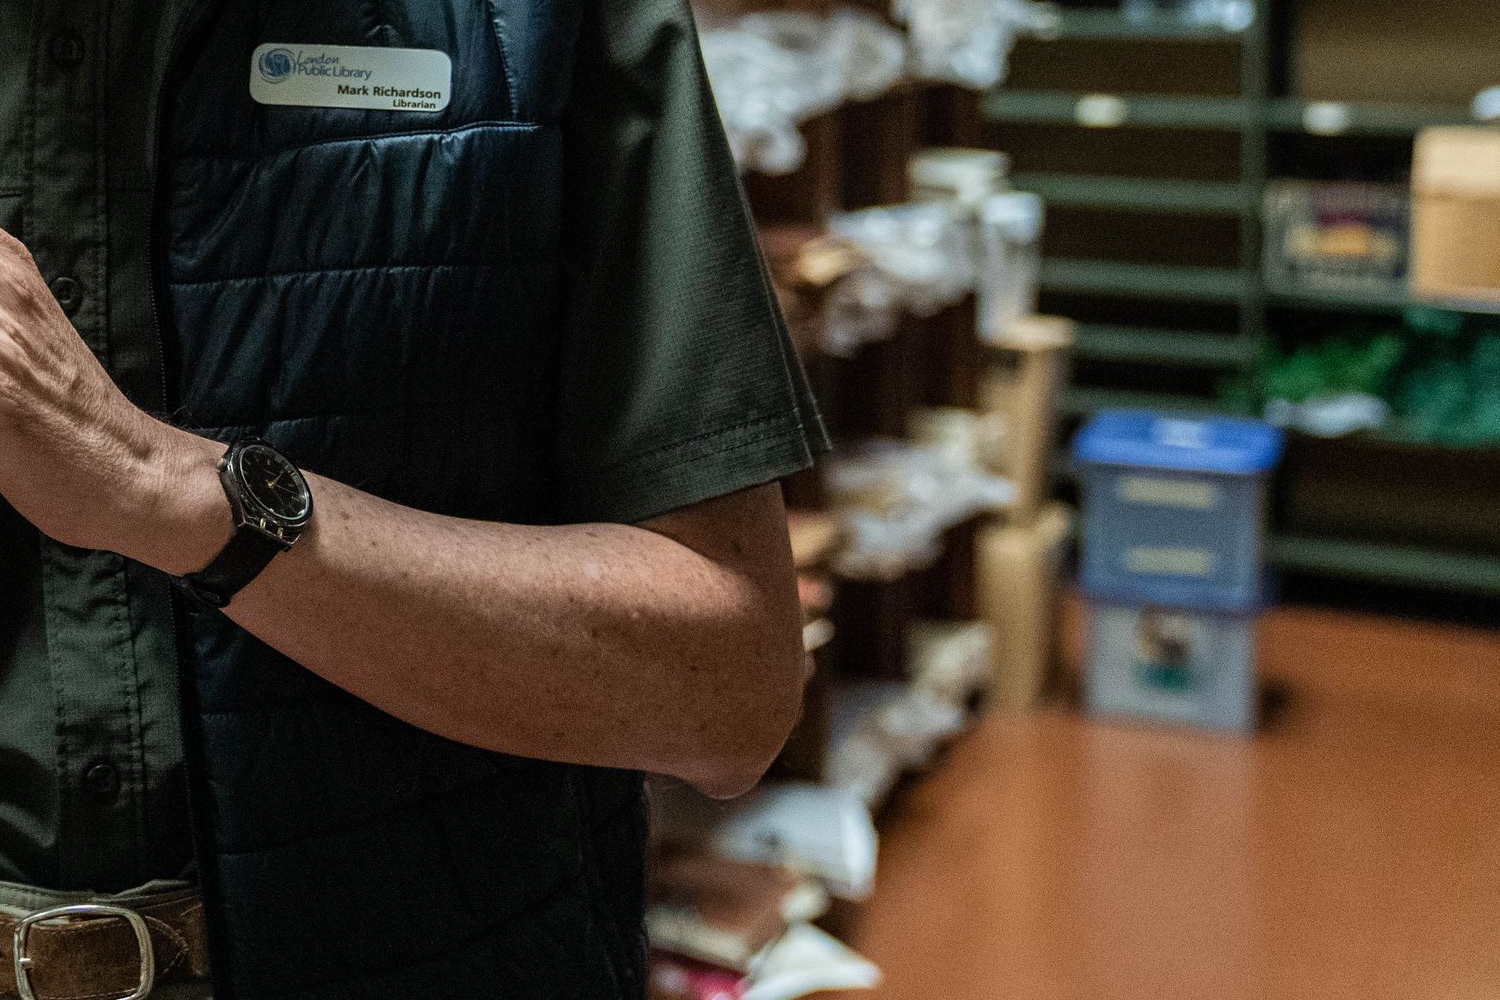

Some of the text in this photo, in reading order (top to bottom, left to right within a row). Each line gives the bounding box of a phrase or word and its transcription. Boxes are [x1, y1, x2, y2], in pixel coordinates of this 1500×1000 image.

[296, 49, 340, 66] London
[337, 84, 442, 100] Mark Richardson
[392, 99, 437, 109] Librarian
